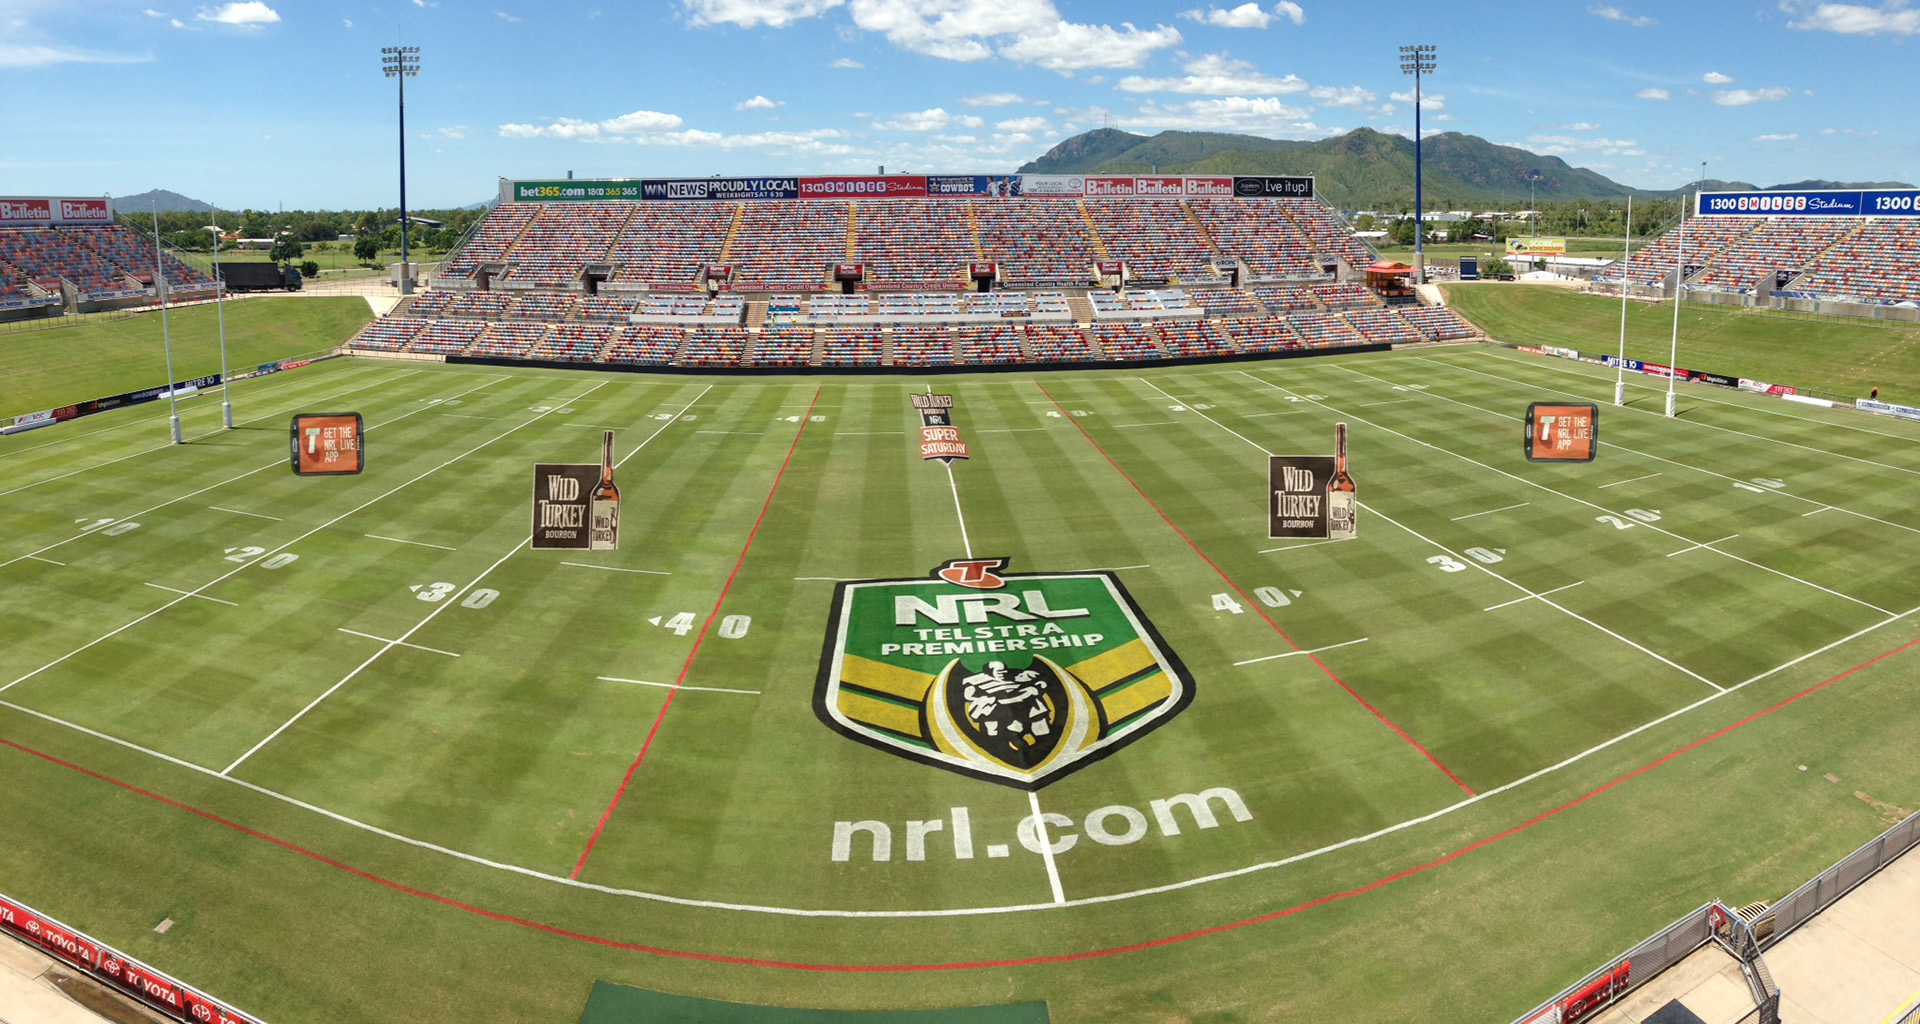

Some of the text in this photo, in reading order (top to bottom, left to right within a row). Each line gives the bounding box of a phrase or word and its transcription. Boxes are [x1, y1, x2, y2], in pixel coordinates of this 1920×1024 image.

[520, 186, 637, 197] bet365.com 1800 365 365
[669, 184, 706, 196] NEWS
[709, 179, 797, 192] PROUDLY LOCAL
[801, 183, 824, 193] 1300
[824, 181, 887, 193] SMILES
[1086, 180, 1132, 194] Bulletin
[1187, 180, 1231, 194] Bulletin
[1285, 180, 1291, 192] it
[1292, 179, 1308, 196] up!
[62, 202, 106, 218] Bulletin
[1709, 196, 1854, 211] 1300 SMILES Stadium
[1875, 196, 1911, 210] 1300
[0, 202, 49, 219] Bulletin
[1607, 356, 1637, 369] MITE 10
[206, 375, 215, 384] 10
[910, 393, 953, 408] WILD TURKEY
[929, 415, 945, 424] NRL
[1558, 416, 1587, 427] GET THE
[323, 427, 352, 438] GET THE
[923, 429, 959, 441] SUPER
[1558, 428, 1589, 439] NRL LIVE
[324, 439, 337, 451] NRL
[340, 438, 355, 451] LIVE
[921, 443, 966, 455] SATURDAY
[1557, 439, 1571, 450] APP
[324, 451, 339, 463] APP
[1282, 466, 1314, 492] WILD
[547, 474, 580, 501] WILD
[1274, 490, 1321, 519] TURKEY
[539, 500, 587, 529] TURKEY
[1332, 506, 1346, 519] WILD
[594, 515, 609, 529] WILD
[1282, 520, 1314, 529] BOURBON
[545, 530, 578, 539] BOURBON
[894, 589, 1091, 627] NRL
[913, 622, 1065, 642] TELSTRA
[881, 633, 1104, 657] PREMIERSHIP
[830, 786, 1254, 863] nrl.com
[46, 930, 89, 961] TOYOTA
[127, 970, 176, 1005] TOYOTA
